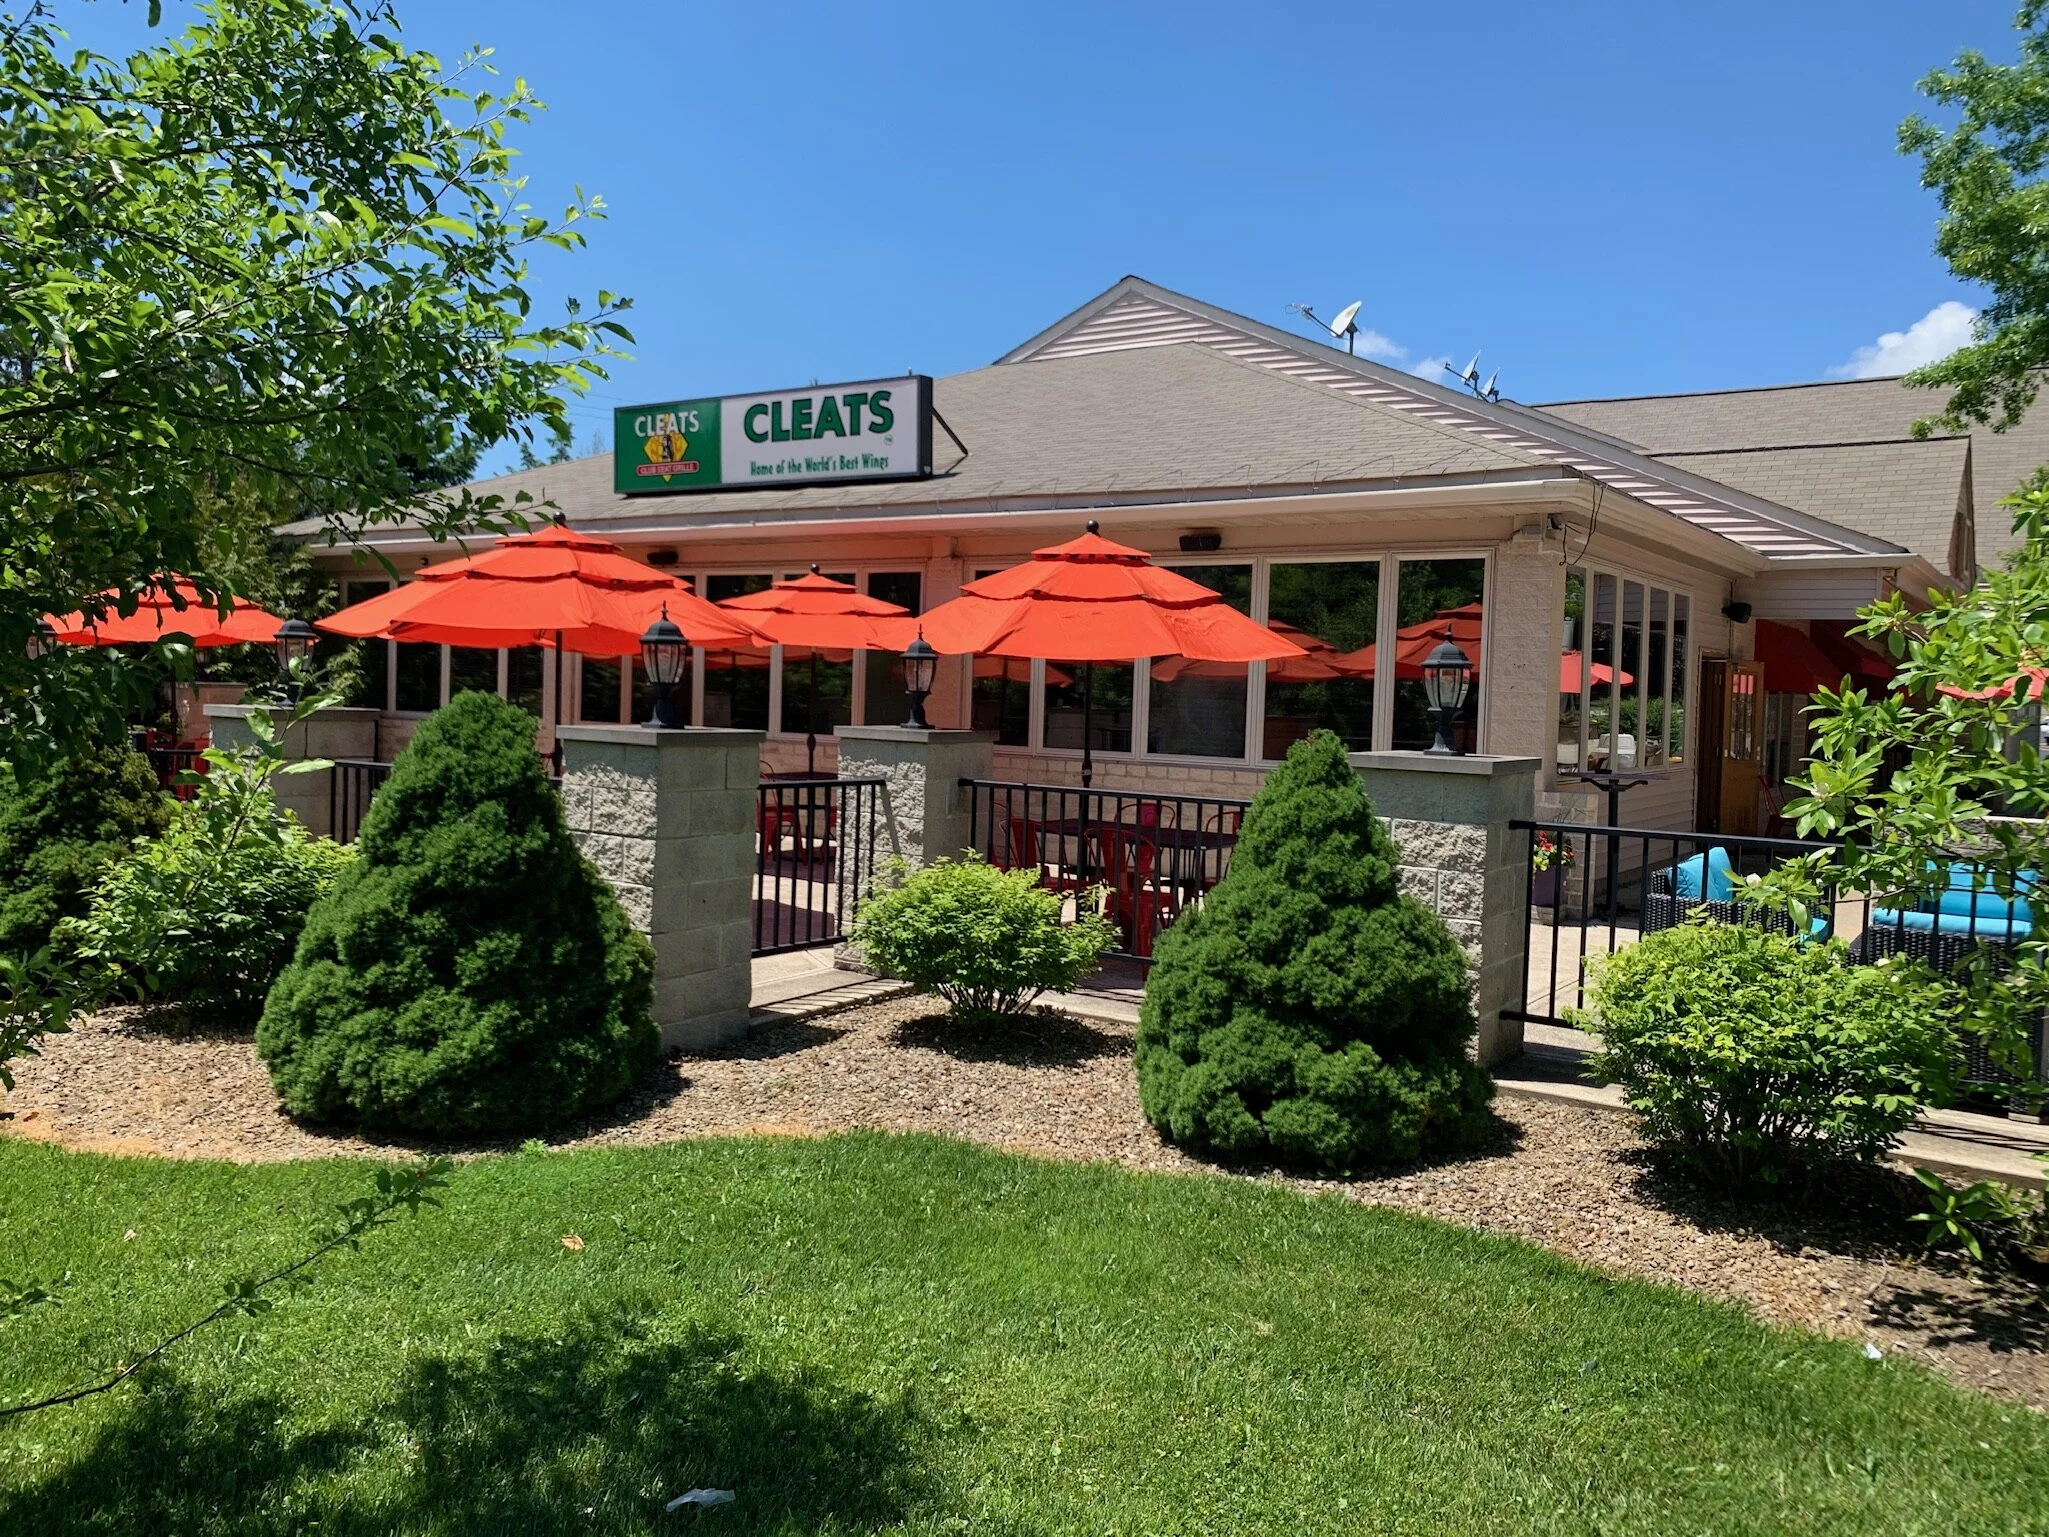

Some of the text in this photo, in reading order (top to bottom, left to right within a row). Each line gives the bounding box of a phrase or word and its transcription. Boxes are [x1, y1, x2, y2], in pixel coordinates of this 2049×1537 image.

[634, 410, 700, 437] CLEATS
[744, 390, 894, 443] CLEATS
[640, 463, 695, 475] CLUB SEAT GRILLE
[750, 453, 889, 476] Home of the World's Best Wings
